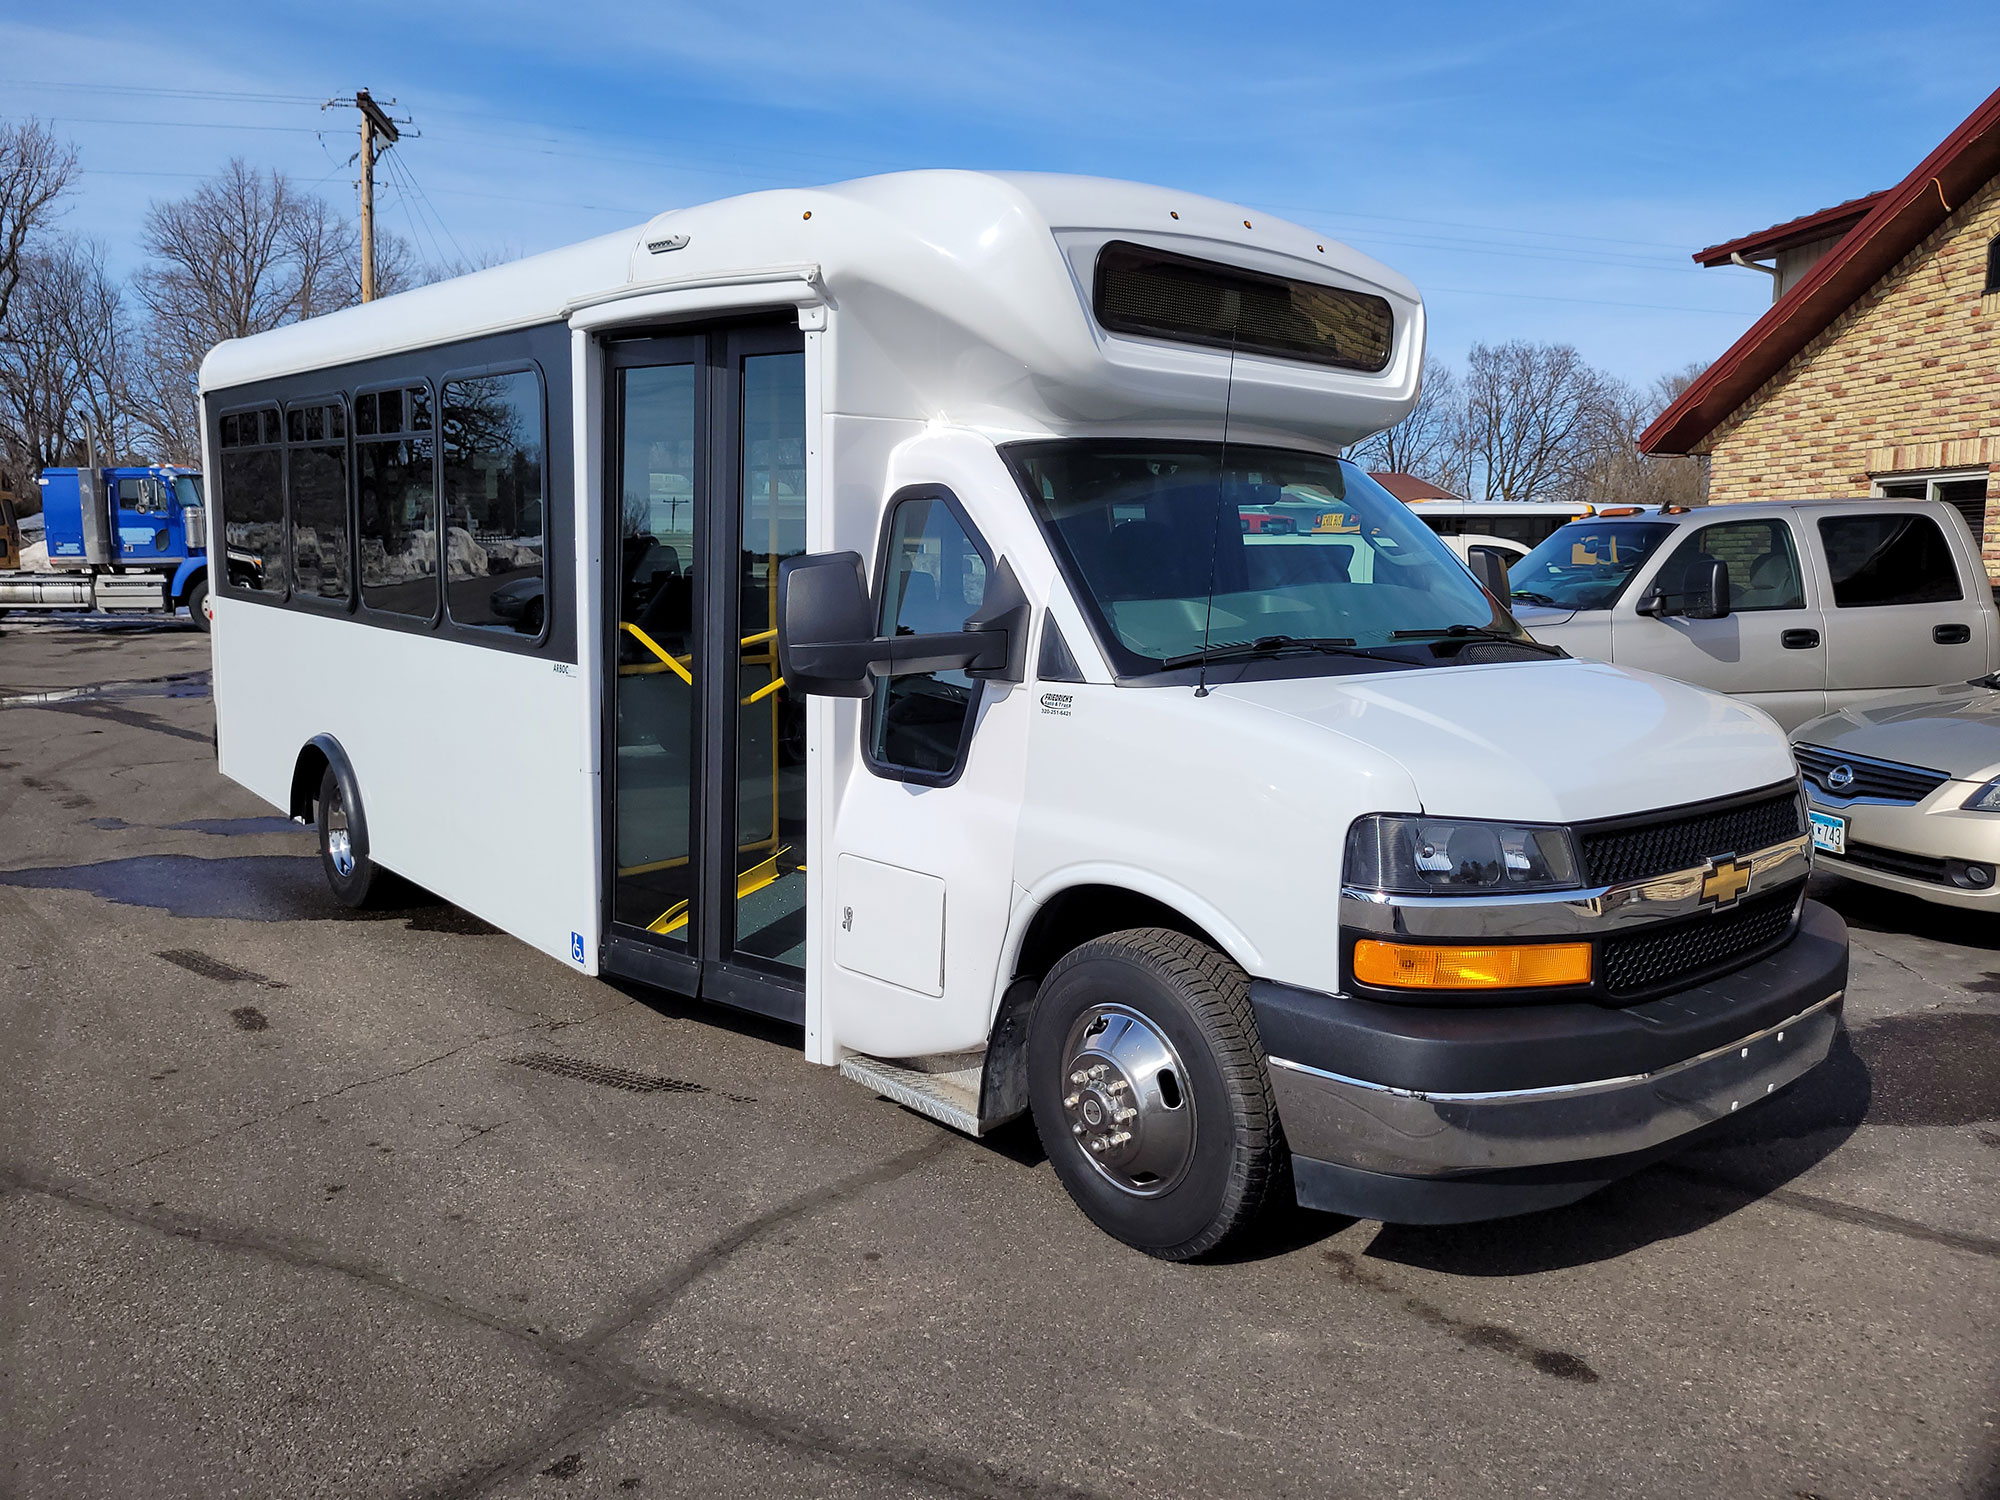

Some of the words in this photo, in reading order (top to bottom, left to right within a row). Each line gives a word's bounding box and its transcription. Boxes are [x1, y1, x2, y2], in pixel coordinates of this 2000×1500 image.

[553, 663, 569, 674] ARBOC
[1041, 708, 1072, 717] 320-251-6421
[1823, 824, 1841, 845] 743
